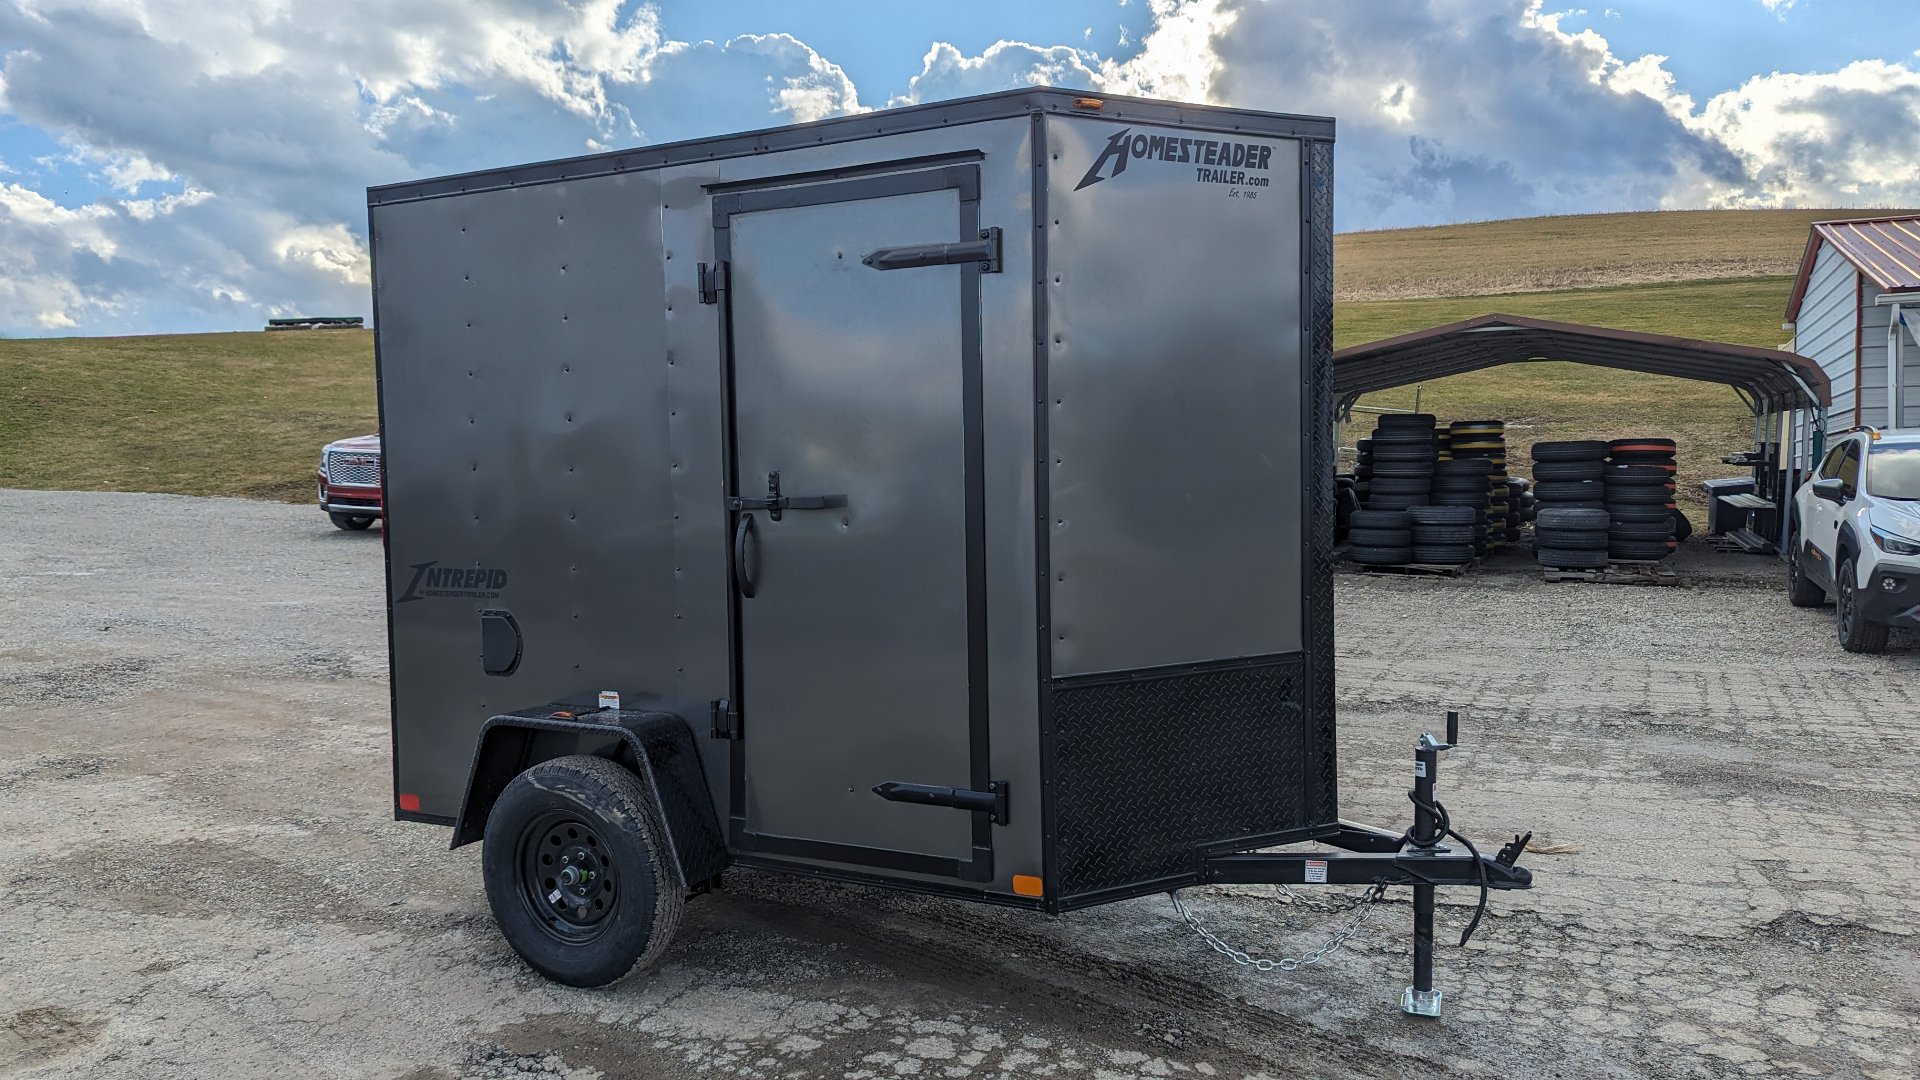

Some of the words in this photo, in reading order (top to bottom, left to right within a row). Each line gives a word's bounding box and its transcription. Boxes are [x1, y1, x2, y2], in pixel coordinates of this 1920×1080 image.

[1073, 127, 1272, 191] HOMESTEADER
[1196, 167, 1269, 187] TRAILER.com
[395, 560, 508, 604] INTREPID
